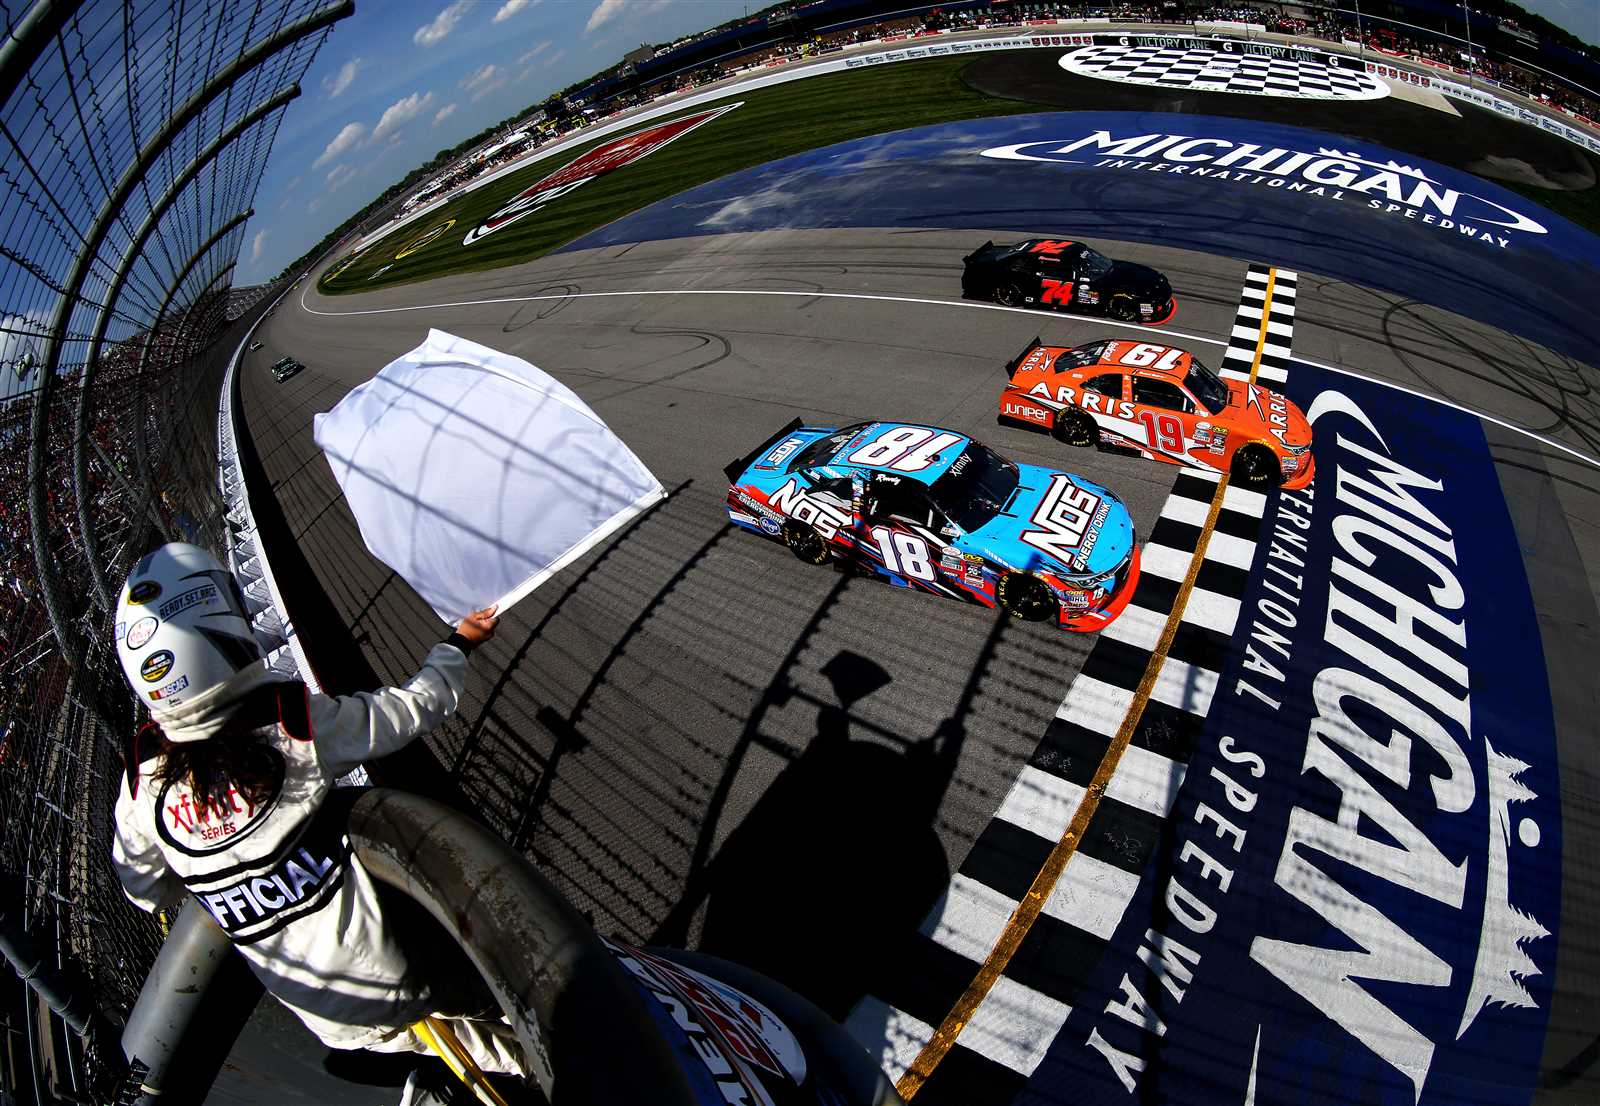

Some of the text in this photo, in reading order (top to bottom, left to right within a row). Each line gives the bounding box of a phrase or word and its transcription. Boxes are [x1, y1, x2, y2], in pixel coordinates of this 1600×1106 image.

[1119, 36, 1129, 46] G
[1136, 37, 1211, 51] VICTORY LANE
[1222, 42, 1233, 52] G
[1241, 43, 1317, 63] VICTORY LANE
[1328, 55, 1339, 67] G
[1048, 129, 1462, 217] MICHIGAN
[1094, 158, 1511, 249] INTERNATIONAL SPEEDWAY
[1040, 278, 1074, 306] 74
[1021, 348, 1047, 372] ARRIS
[1119, 343, 1184, 371] 19
[1029, 382, 1136, 419] ARRIS
[1269, 389, 1288, 445] ARRIS
[768, 438, 805, 466] NOS
[848, 426, 964, 472] 18
[1138, 410, 1186, 455] 19
[768, 478, 854, 541] NOS
[1019, 474, 1102, 567] NOS
[870, 525, 937, 582] 18
[1073, 527, 1099, 572] ENERGY
[1094, 501, 1113, 529] DRINK
[1091, 587, 1105, 601] 18
[1085, 481, 1316, 1094] TERNATIONAL SPEEDWAY
[1249, 433, 1477, 1106] MICHIGAN
[201, 822, 237, 840] SERIES
[198, 847, 333, 929] FFICIAL
